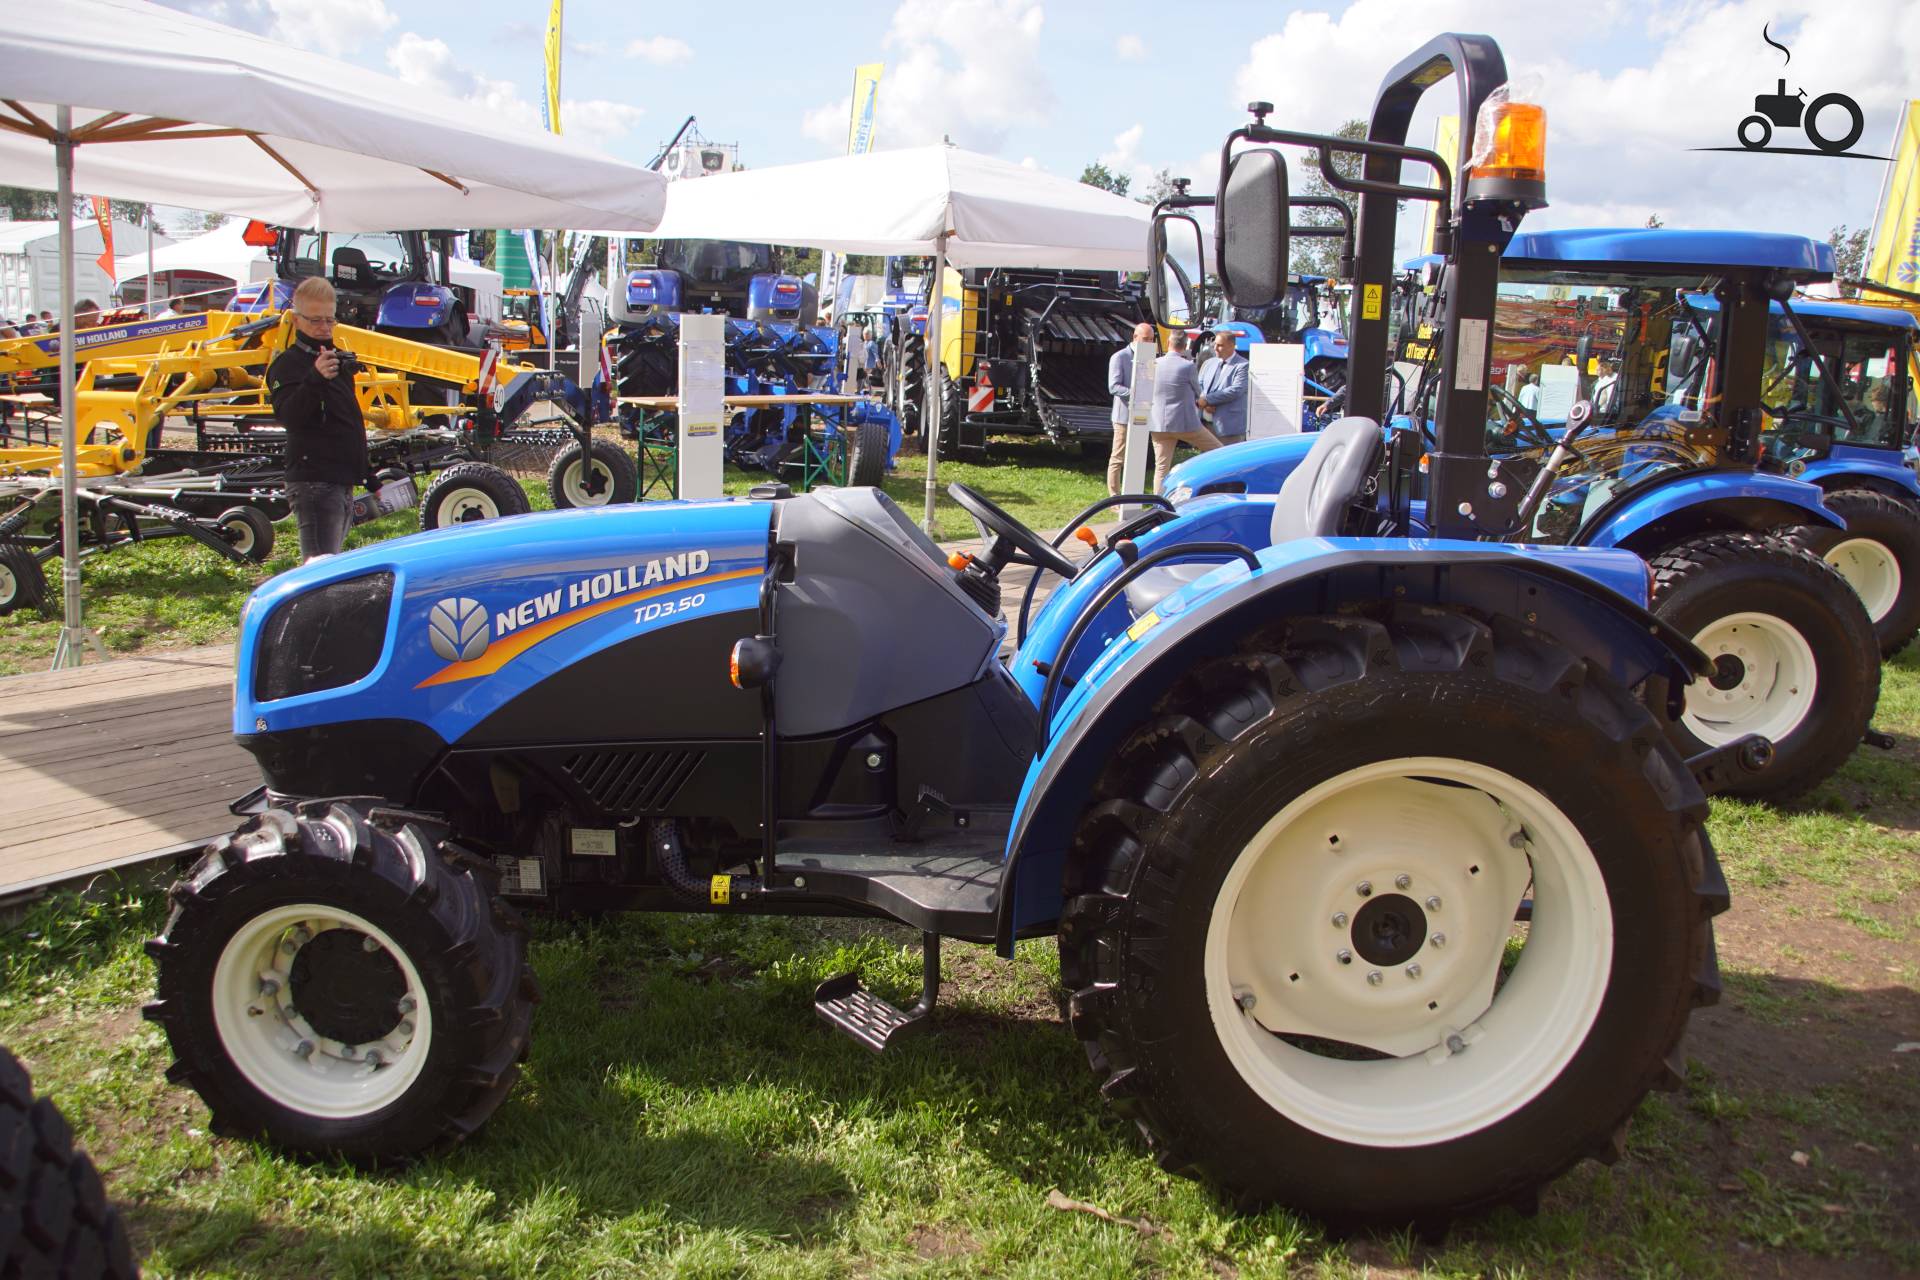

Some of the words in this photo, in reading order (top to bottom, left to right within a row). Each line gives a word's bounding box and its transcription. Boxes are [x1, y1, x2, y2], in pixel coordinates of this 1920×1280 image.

[87, 329, 128, 344] HOLLAND
[495, 388, 503, 405] 40
[496, 589, 562, 637] NEW
[568, 549, 710, 609] HOLLAND
[634, 593, 706, 625] TD3.50
